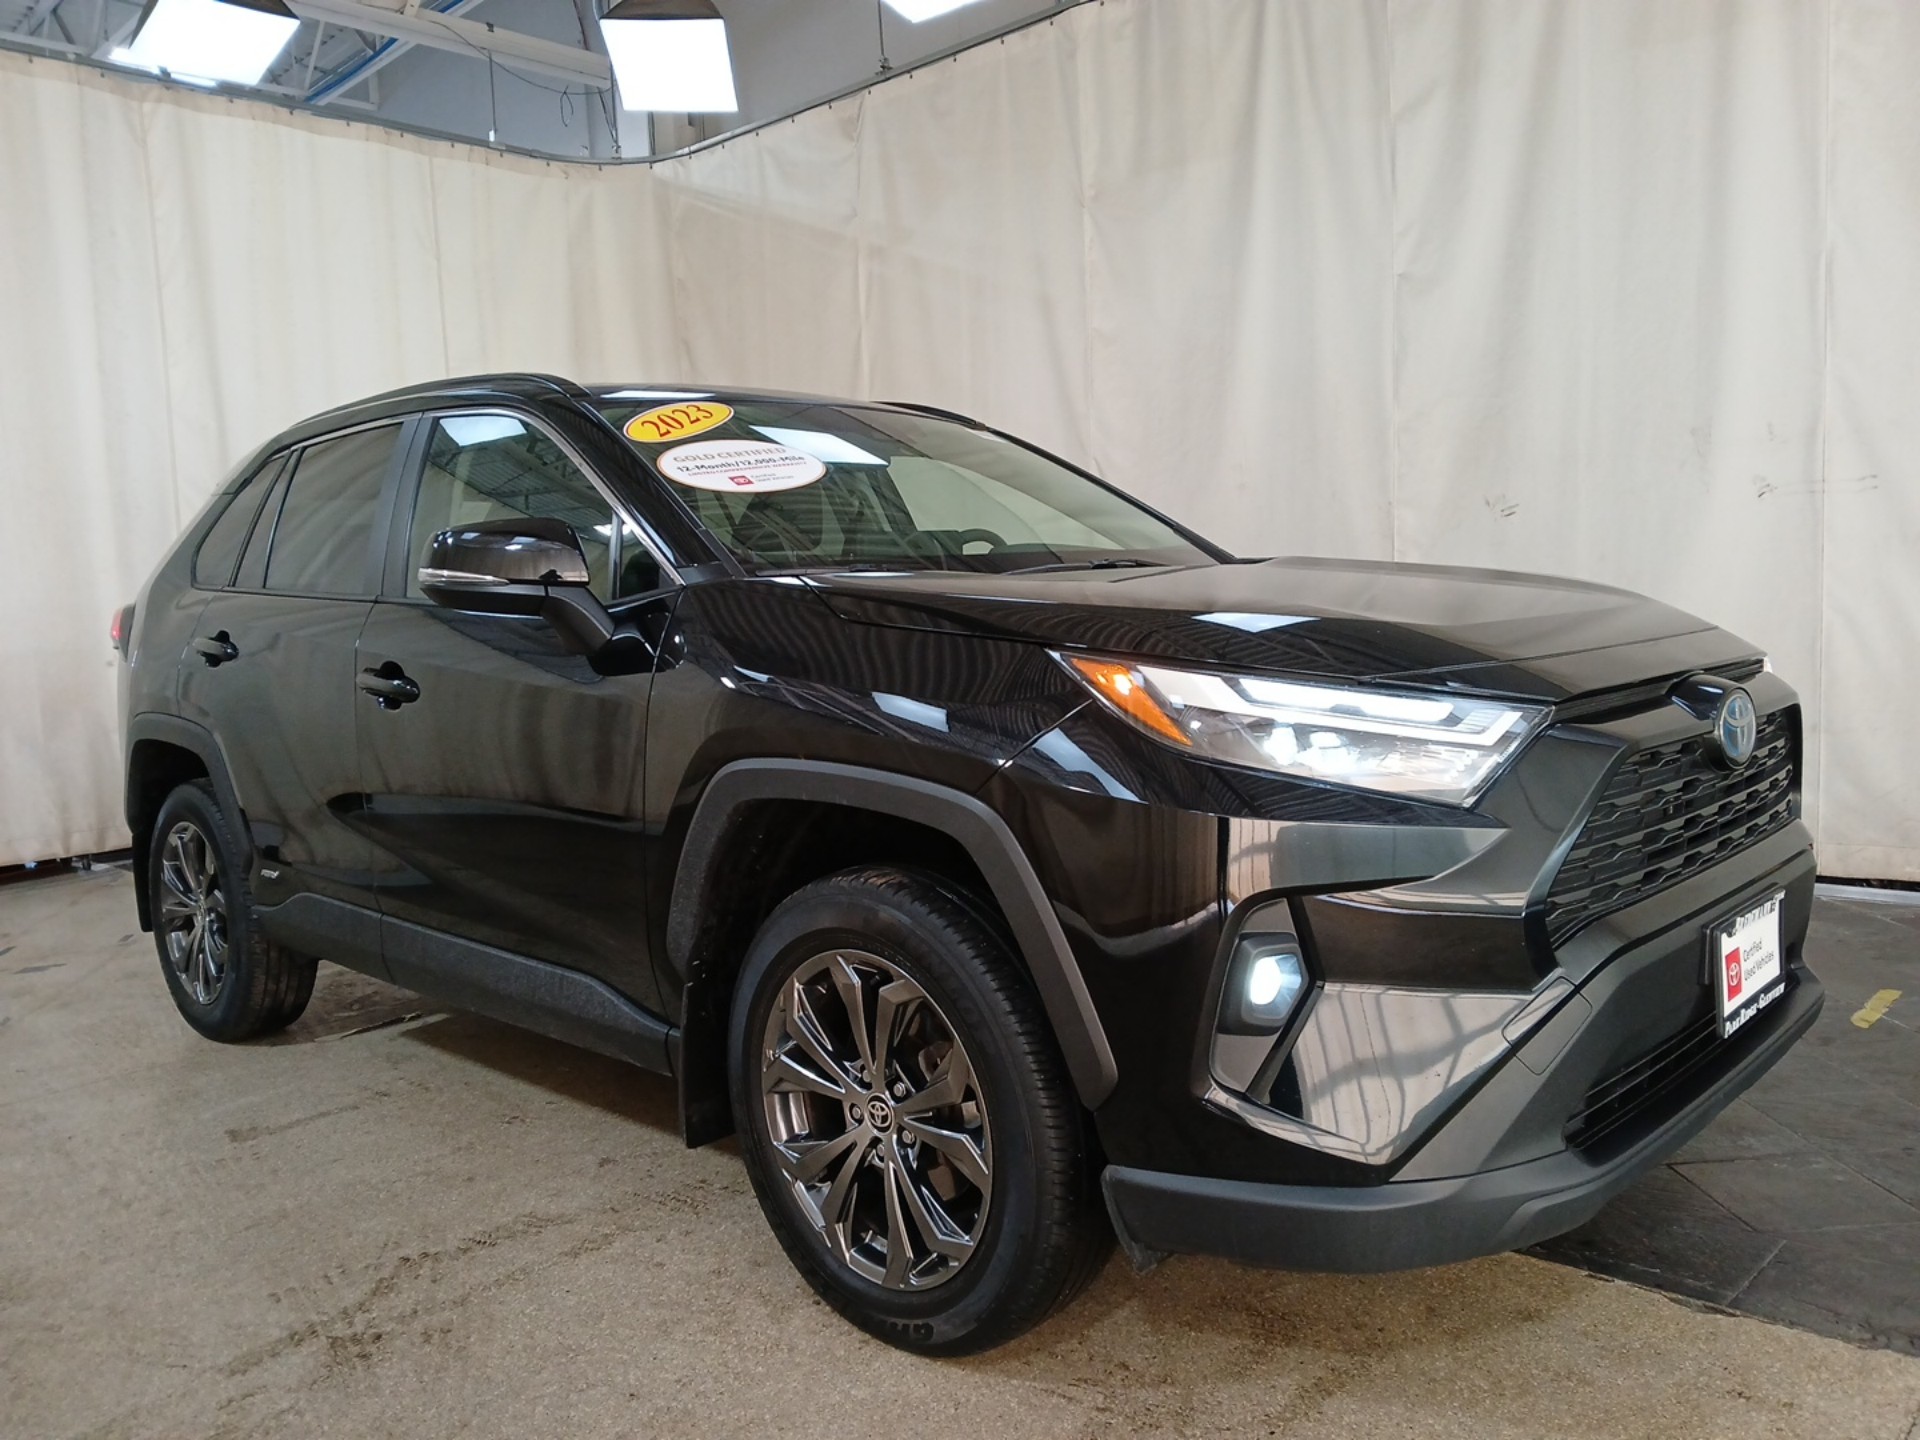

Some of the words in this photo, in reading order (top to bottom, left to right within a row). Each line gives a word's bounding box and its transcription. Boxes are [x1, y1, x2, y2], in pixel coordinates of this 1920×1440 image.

[641, 404, 713, 437] 2023
[673, 453, 715, 462] GOLD
[717, 448, 786, 458] CERTIFIED
